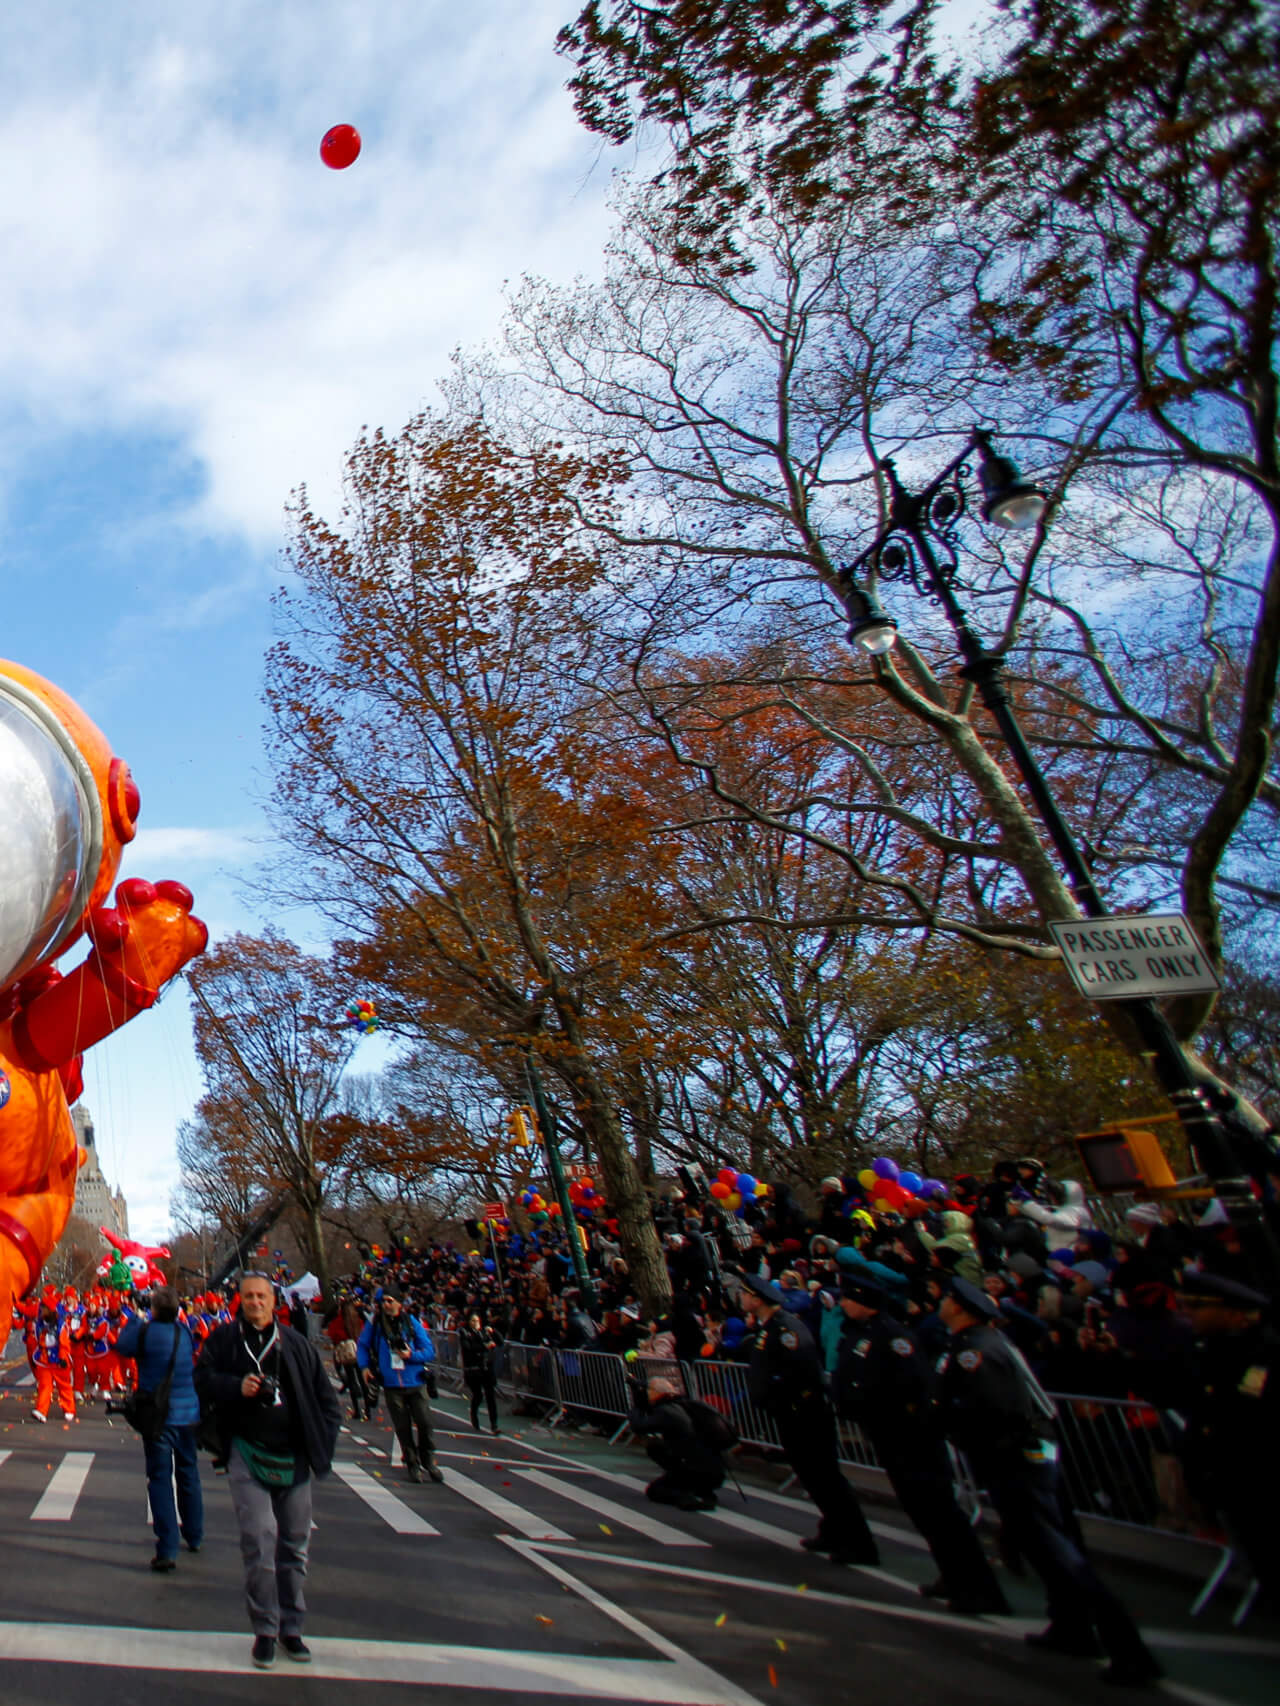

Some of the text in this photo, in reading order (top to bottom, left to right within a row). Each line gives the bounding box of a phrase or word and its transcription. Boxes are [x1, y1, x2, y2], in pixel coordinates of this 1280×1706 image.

[1063, 925, 1188, 953] PASSENGER
[1078, 954, 1201, 983] CARS ONLY
